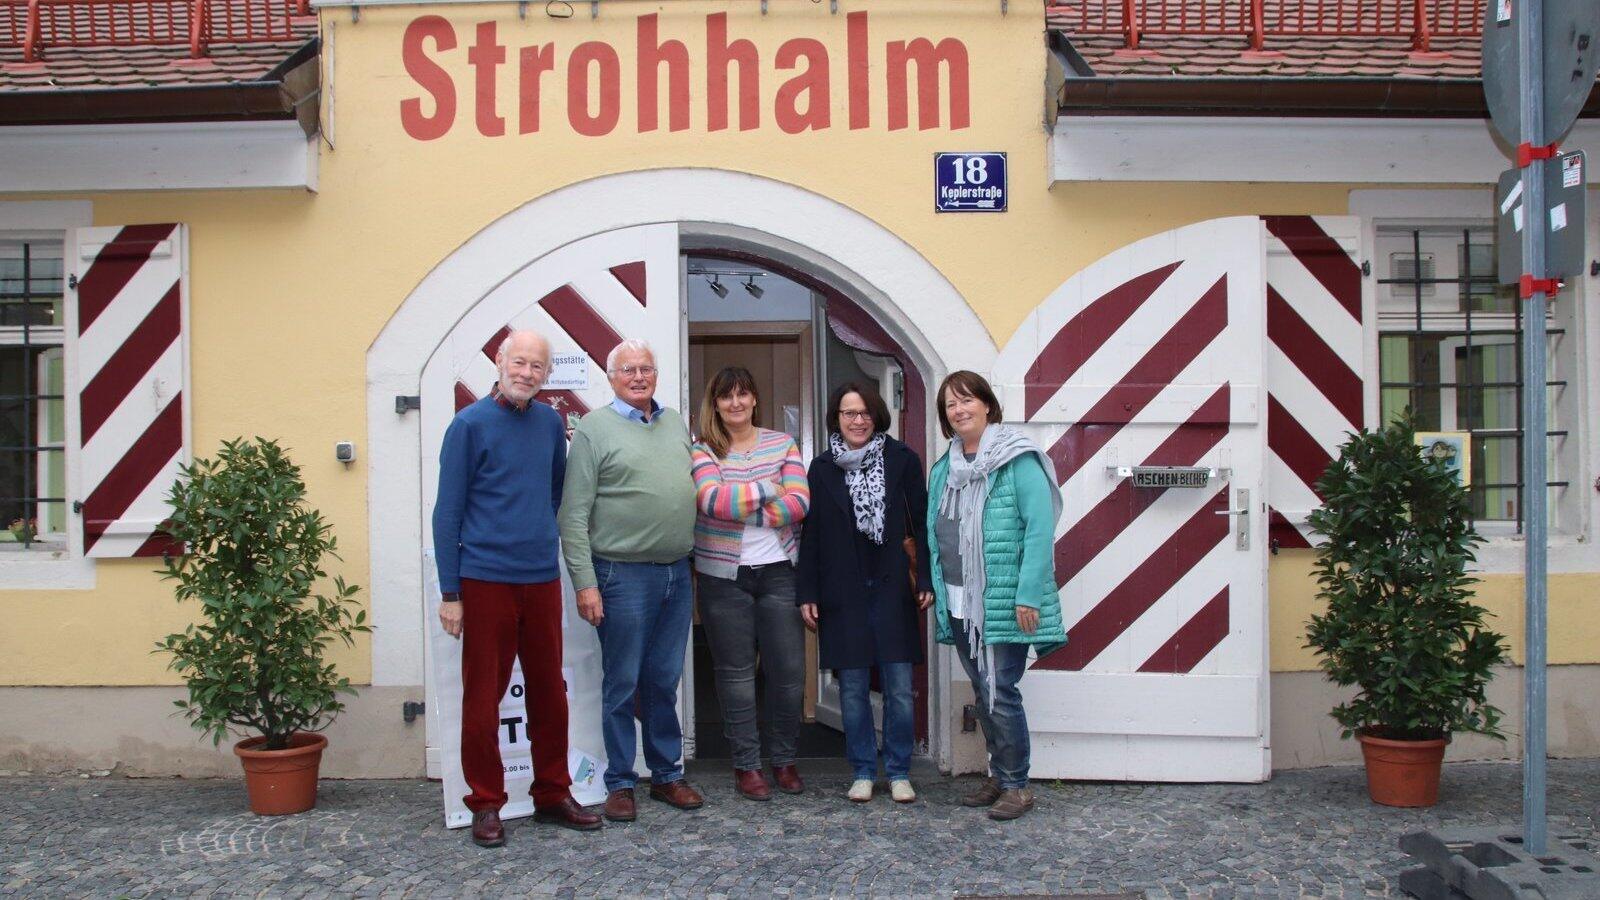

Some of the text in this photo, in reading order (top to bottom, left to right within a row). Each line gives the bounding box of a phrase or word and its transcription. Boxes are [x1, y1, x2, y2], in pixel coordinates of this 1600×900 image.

[400, 10, 970, 141] Strohhalm
[952, 157, 988, 184] 18
[941, 185, 1003, 200] Keplerstraße
